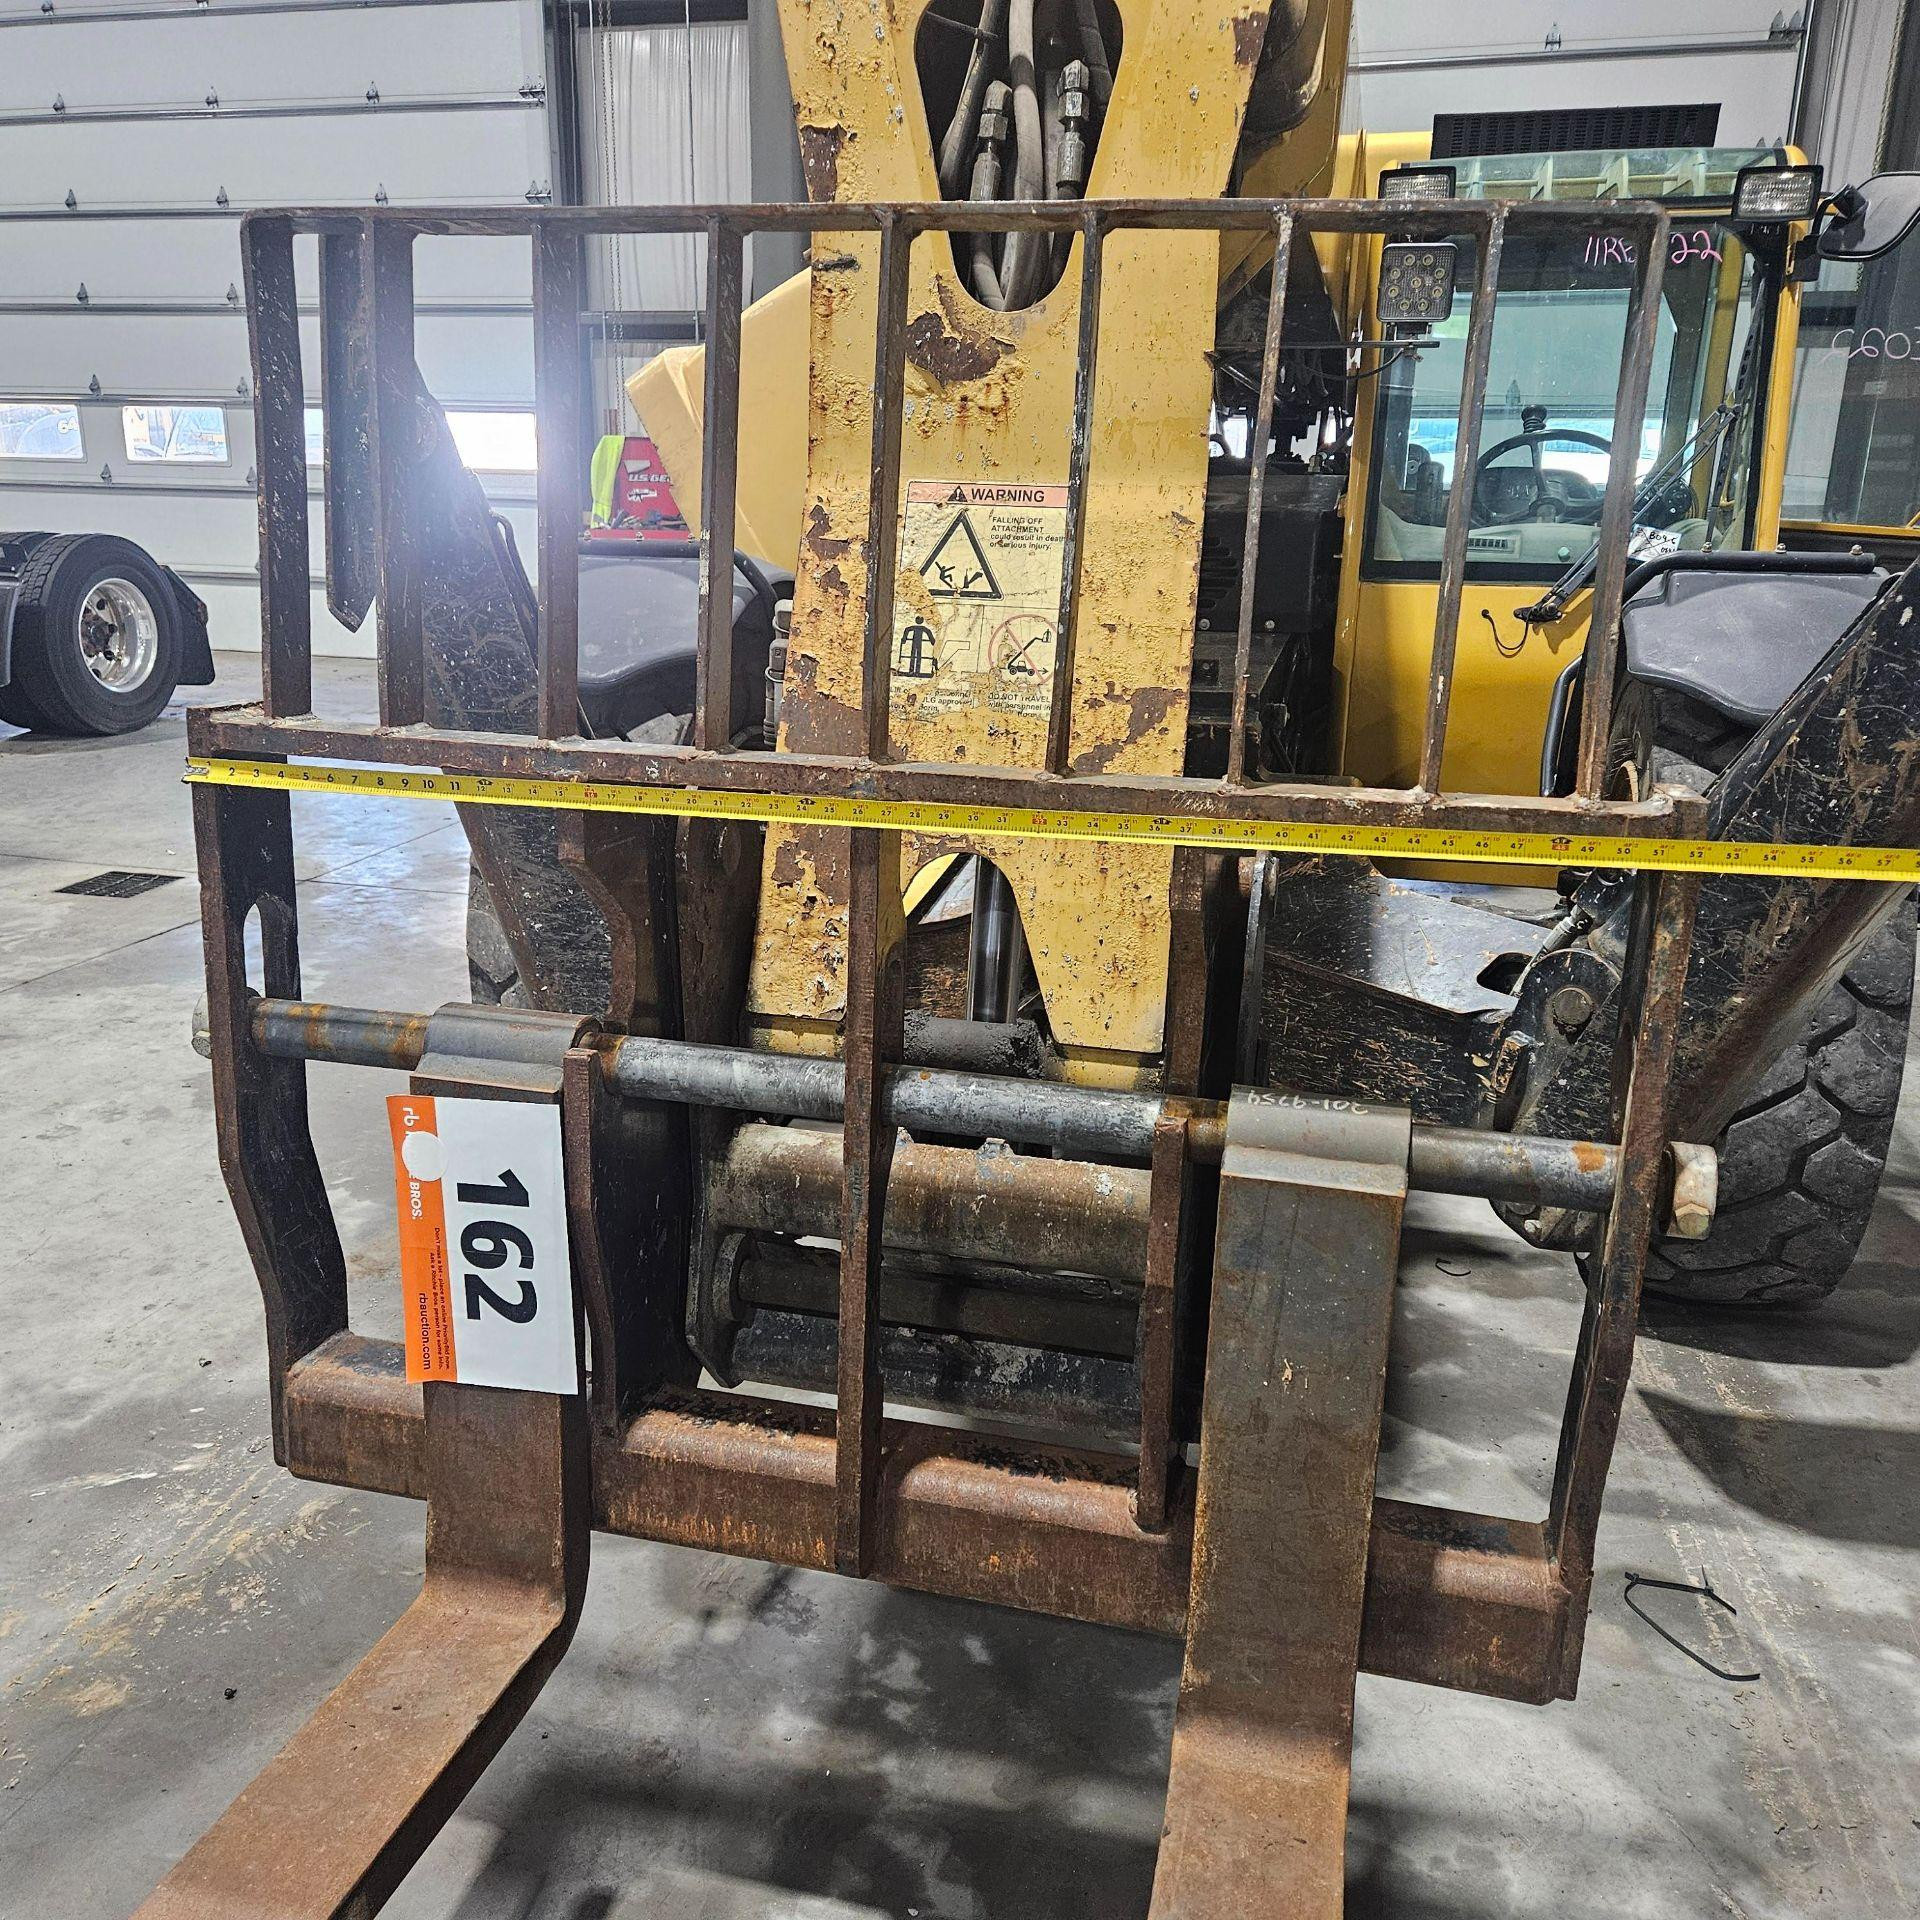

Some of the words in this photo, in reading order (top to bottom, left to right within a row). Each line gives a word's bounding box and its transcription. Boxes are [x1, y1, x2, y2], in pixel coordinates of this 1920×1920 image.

[971, 488, 1045, 503] WARNING
[991, 525, 1044, 533] ATTACHMENT
[992, 516, 1025, 525] FALLING
[1027, 517, 1044, 525] OFF
[229, 767, 235, 776] 2
[253, 769, 260, 777] 3
[277, 770, 284, 779] 4
[303, 772, 309, 780] 5
[327, 774, 334, 782] 6
[352, 775, 358, 784] 7
[377, 777, 384, 786] 8
[401, 778, 409, 787] 9
[422, 779, 434, 789] 10
[450, 781, 460, 790] 11
[1726, 852, 1740, 860] 53
[1838, 857, 1853, 865] 56
[402, 1107, 420, 1127] rb
[457, 1168, 538, 1324] 162
[440, 1296, 445, 1304] an
[419, 1293, 431, 1370] rbauction.com
